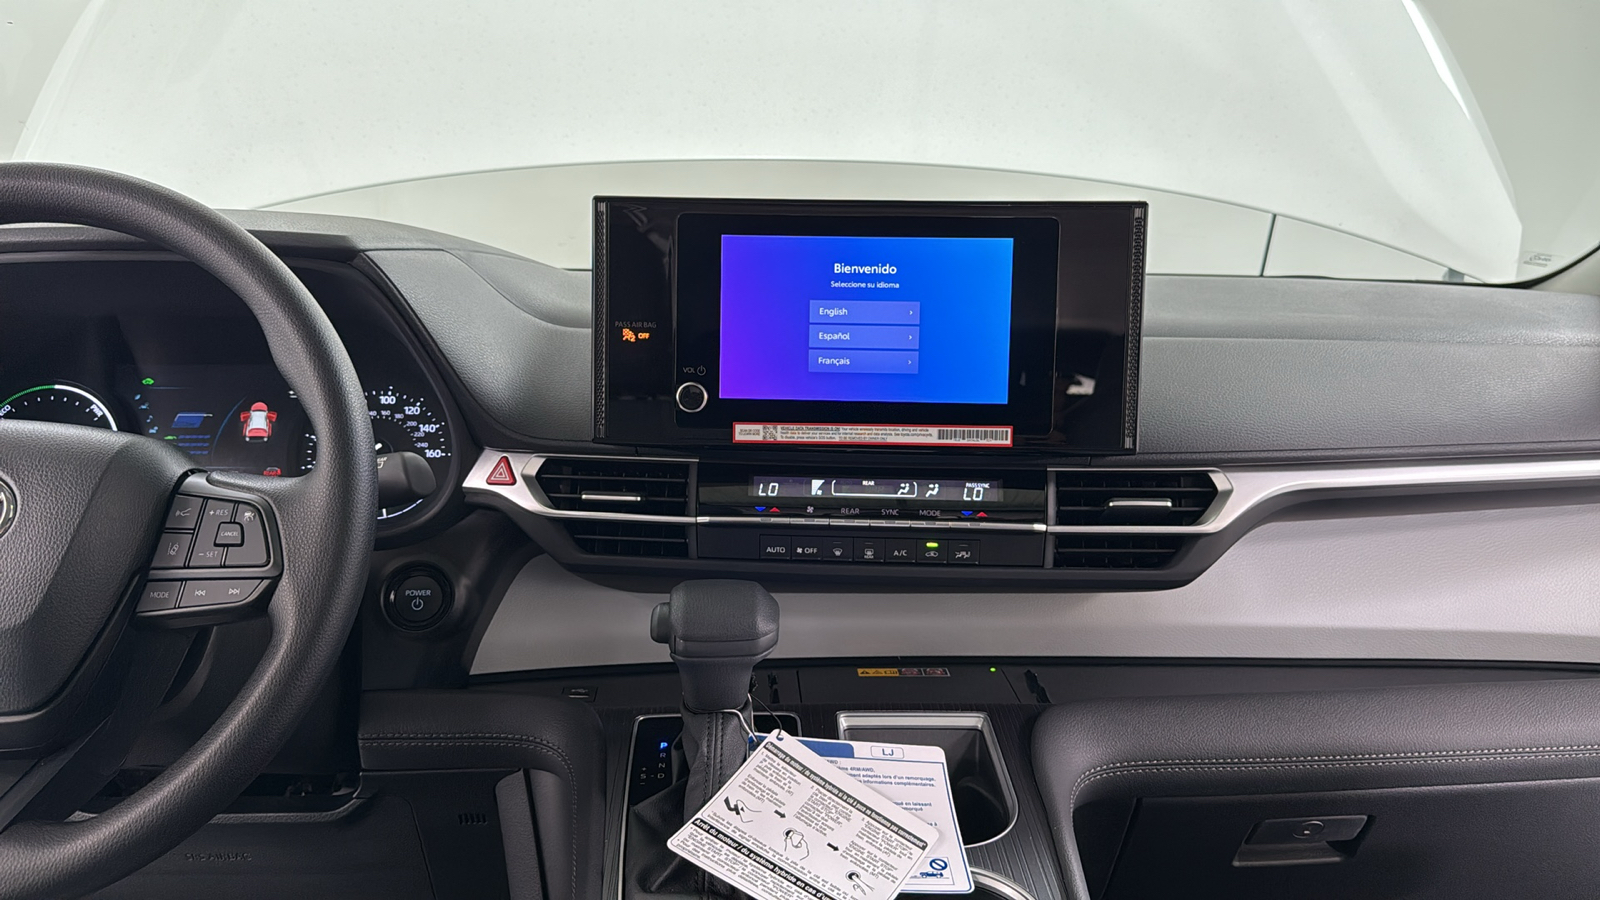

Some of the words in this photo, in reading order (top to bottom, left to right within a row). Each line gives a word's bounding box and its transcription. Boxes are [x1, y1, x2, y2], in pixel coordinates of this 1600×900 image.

[834, 263, 897, 274] Bienvenido
[877, 281, 900, 289] idioma
[819, 307, 848, 317] English
[644, 321, 657, 329] BAG
[818, 332, 850, 342] Español
[818, 357, 850, 367] Français
[380, 396, 396, 405] 100
[404, 406, 421, 415] 120
[419, 424, 437, 433] 140
[425, 449, 442, 459] 160
[758, 483, 779, 496] LO
[963, 487, 984, 501] LO
[840, 507, 860, 515] REAR
[881, 508, 899, 516] SYNC
[919, 509, 941, 517] MODE
[766, 546, 786, 554] AUTO
[893, 549, 908, 557] A/C
[149, 591, 169, 599] MODE
[405, 589, 432, 597] POWER
[882, 748, 894, 757] LJ
[692, 817, 711, 831] Arrêt
[707, 827, 719, 836] du
[715, 832, 740, 848] moteur
[739, 846, 751, 855] du
[747, 851, 775, 870] système
[771, 865, 798, 884] hybride
[795, 880, 806, 888] en
[803, 884, 817, 894] cas
